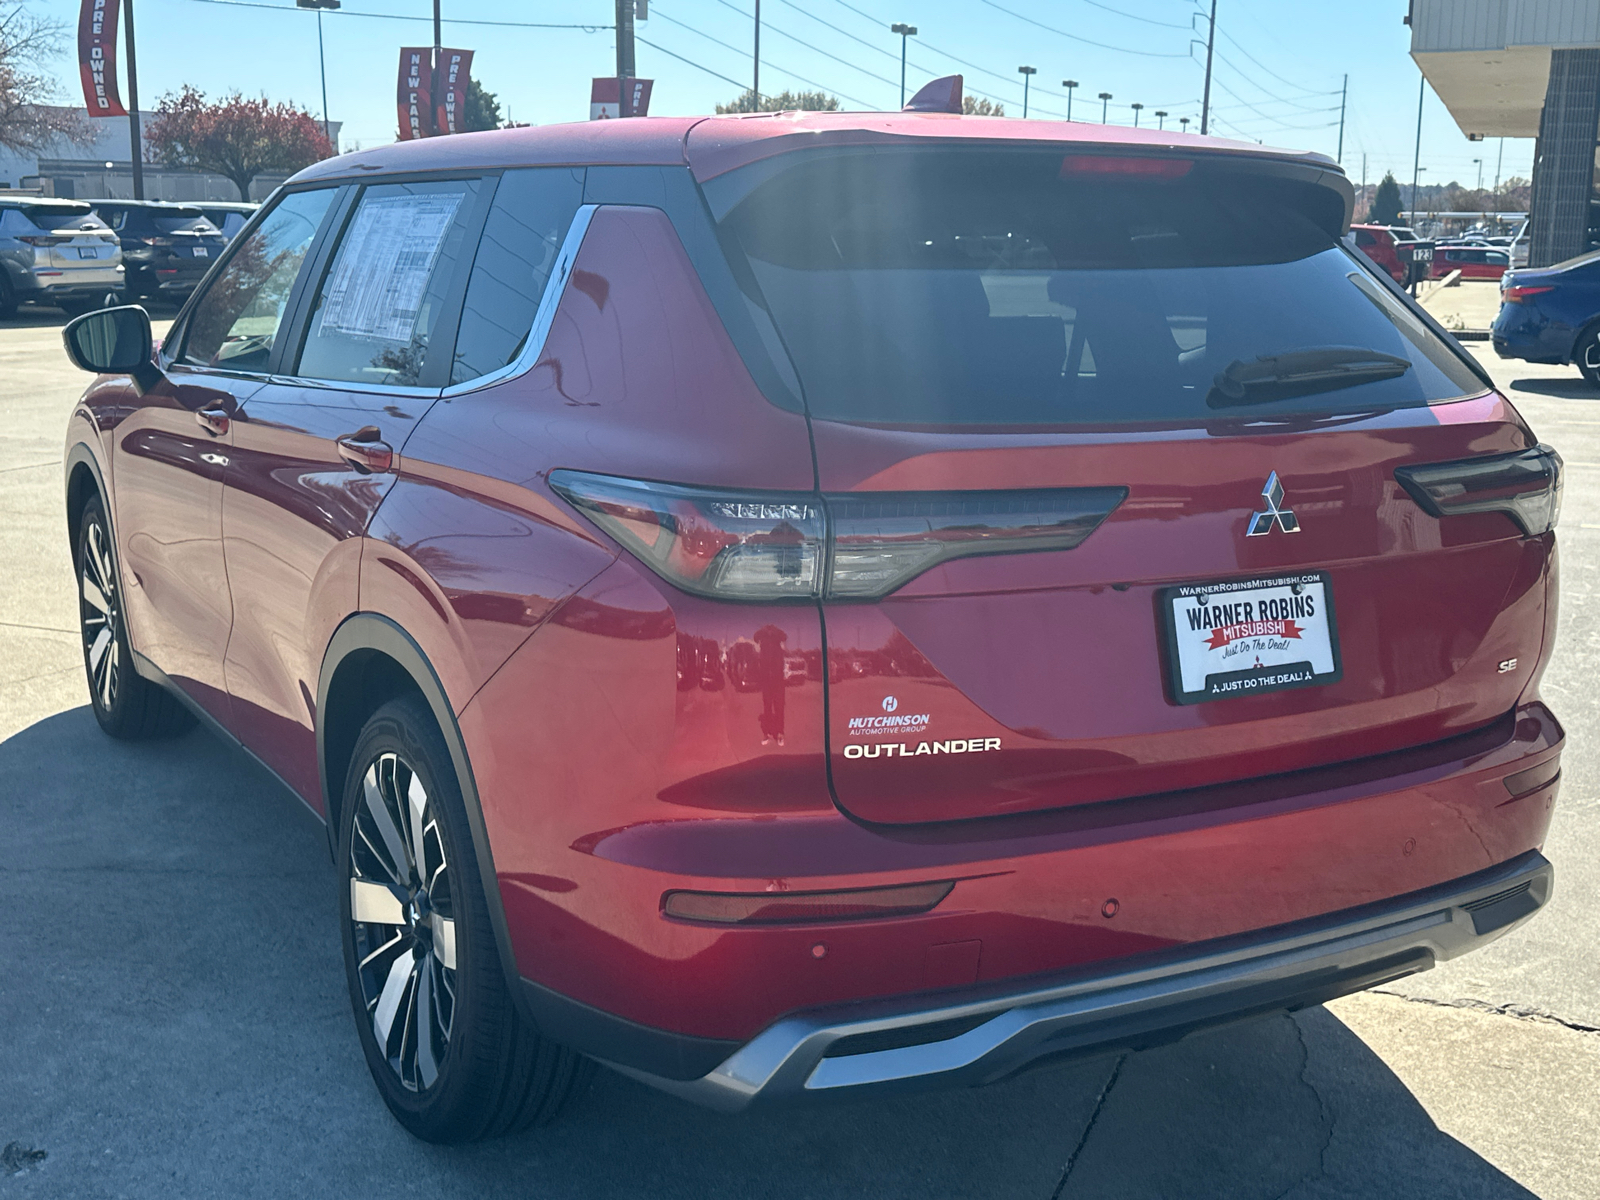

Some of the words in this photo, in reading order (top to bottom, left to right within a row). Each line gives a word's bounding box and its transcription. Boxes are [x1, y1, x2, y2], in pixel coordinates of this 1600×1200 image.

[90, 0, 109, 108] PRE-OWNED
[408, 54, 420, 88] NEW
[445, 55, 461, 135] PRE-OWNE
[409, 93, 421, 139] CARS
[1414, 249, 1431, 261] 123
[1186, 602, 1254, 631] WARNER
[1258, 595, 1315, 622] ROBINS
[1222, 620, 1285, 641] MITSUBISHI
[1222, 644, 1239, 659] Just
[1240, 641, 1250, 652] Do
[1252, 639, 1266, 651] The
[1267, 638, 1291, 651] Deal!
[1497, 658, 1518, 674] SE
[1220, 682, 1243, 692] JUST
[1244, 679, 1258, 688] DO
[1258, 676, 1276, 686] THE
[1277, 672, 1303, 684] DEAL!
[848, 714, 930, 729] HUTCHINSON
[849, 726, 899, 736] AUTOMOTIVE
[900, 725, 926, 734] GROUP
[843, 737, 1001, 759] OUTLANDER
